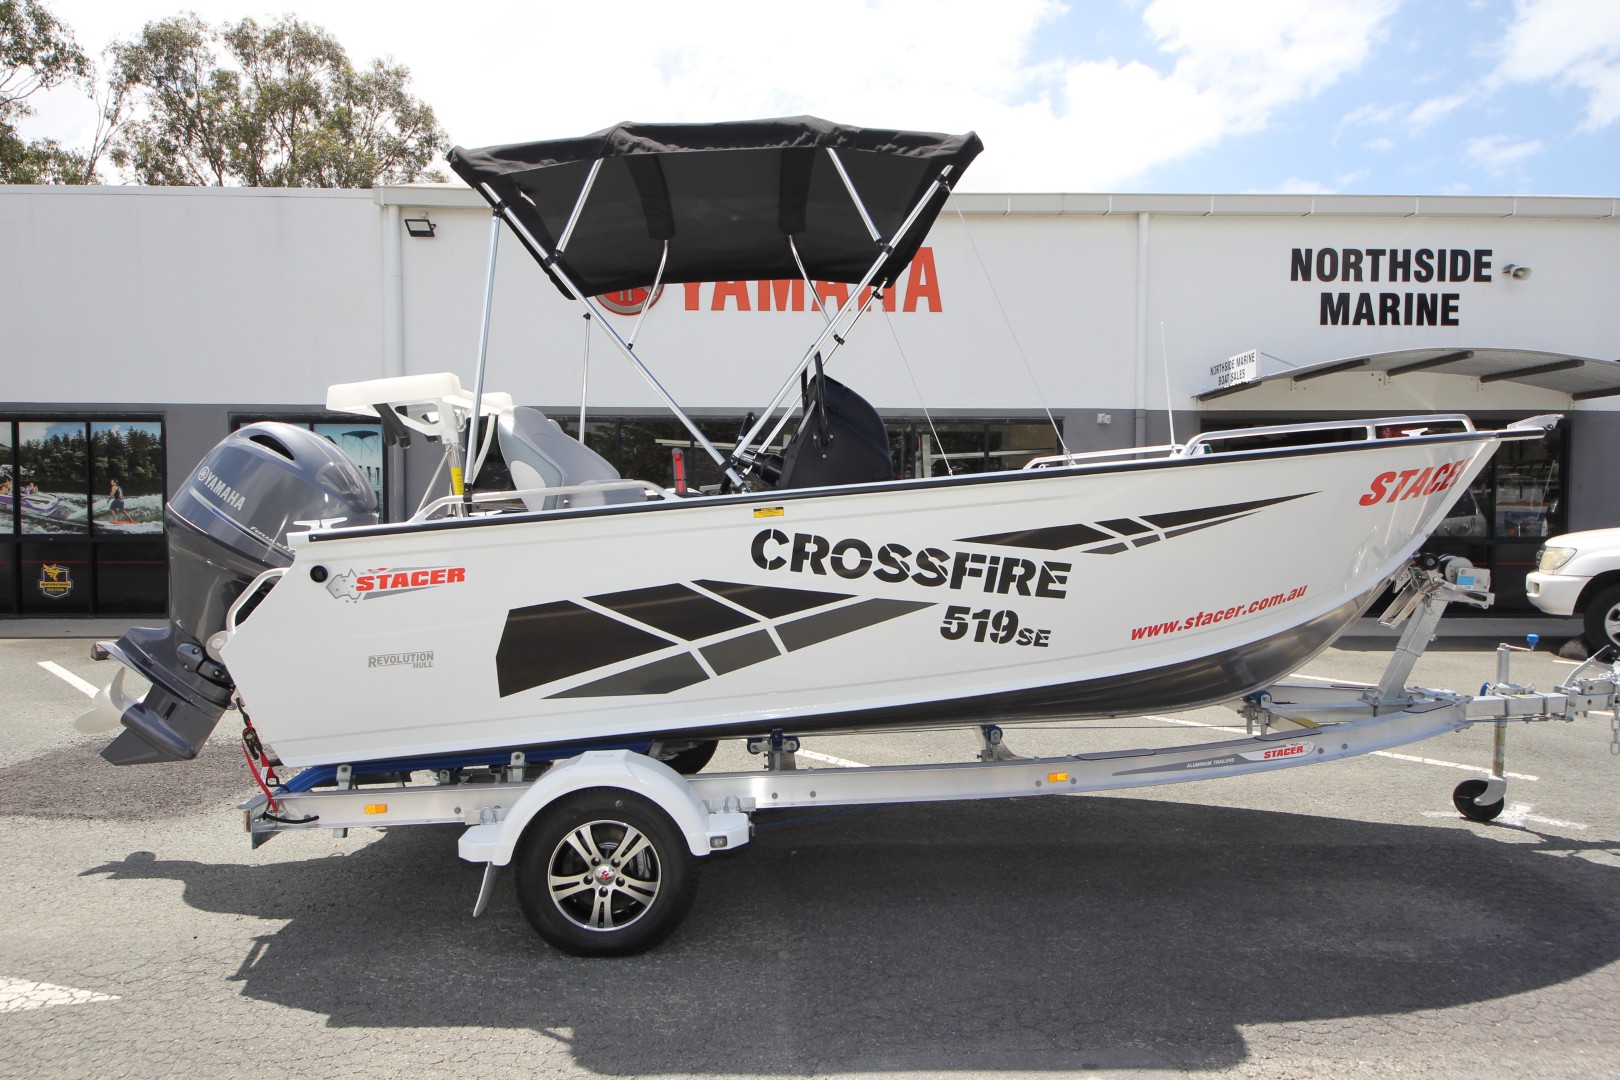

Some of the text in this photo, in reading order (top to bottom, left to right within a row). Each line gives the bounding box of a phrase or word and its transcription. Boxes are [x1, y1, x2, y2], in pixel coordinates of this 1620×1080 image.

[1291, 248, 1493, 283] NORTHSIDE
[1320, 292, 1460, 326] MARINE
[1210, 352, 1255, 376] NORTHSIDE MARINE
[1218, 369, 1246, 386] BOAT SALES
[204, 472, 246, 511] YAMAHA
[751, 529, 1073, 600] CROSSFIRE
[356, 568, 466, 592] STACER
[1131, 585, 1308, 641] www.stacer.com.au
[368, 652, 434, 668] REVOLUTION
[413, 661, 434, 669] HULL
[1264, 746, 1304, 759] STACER
